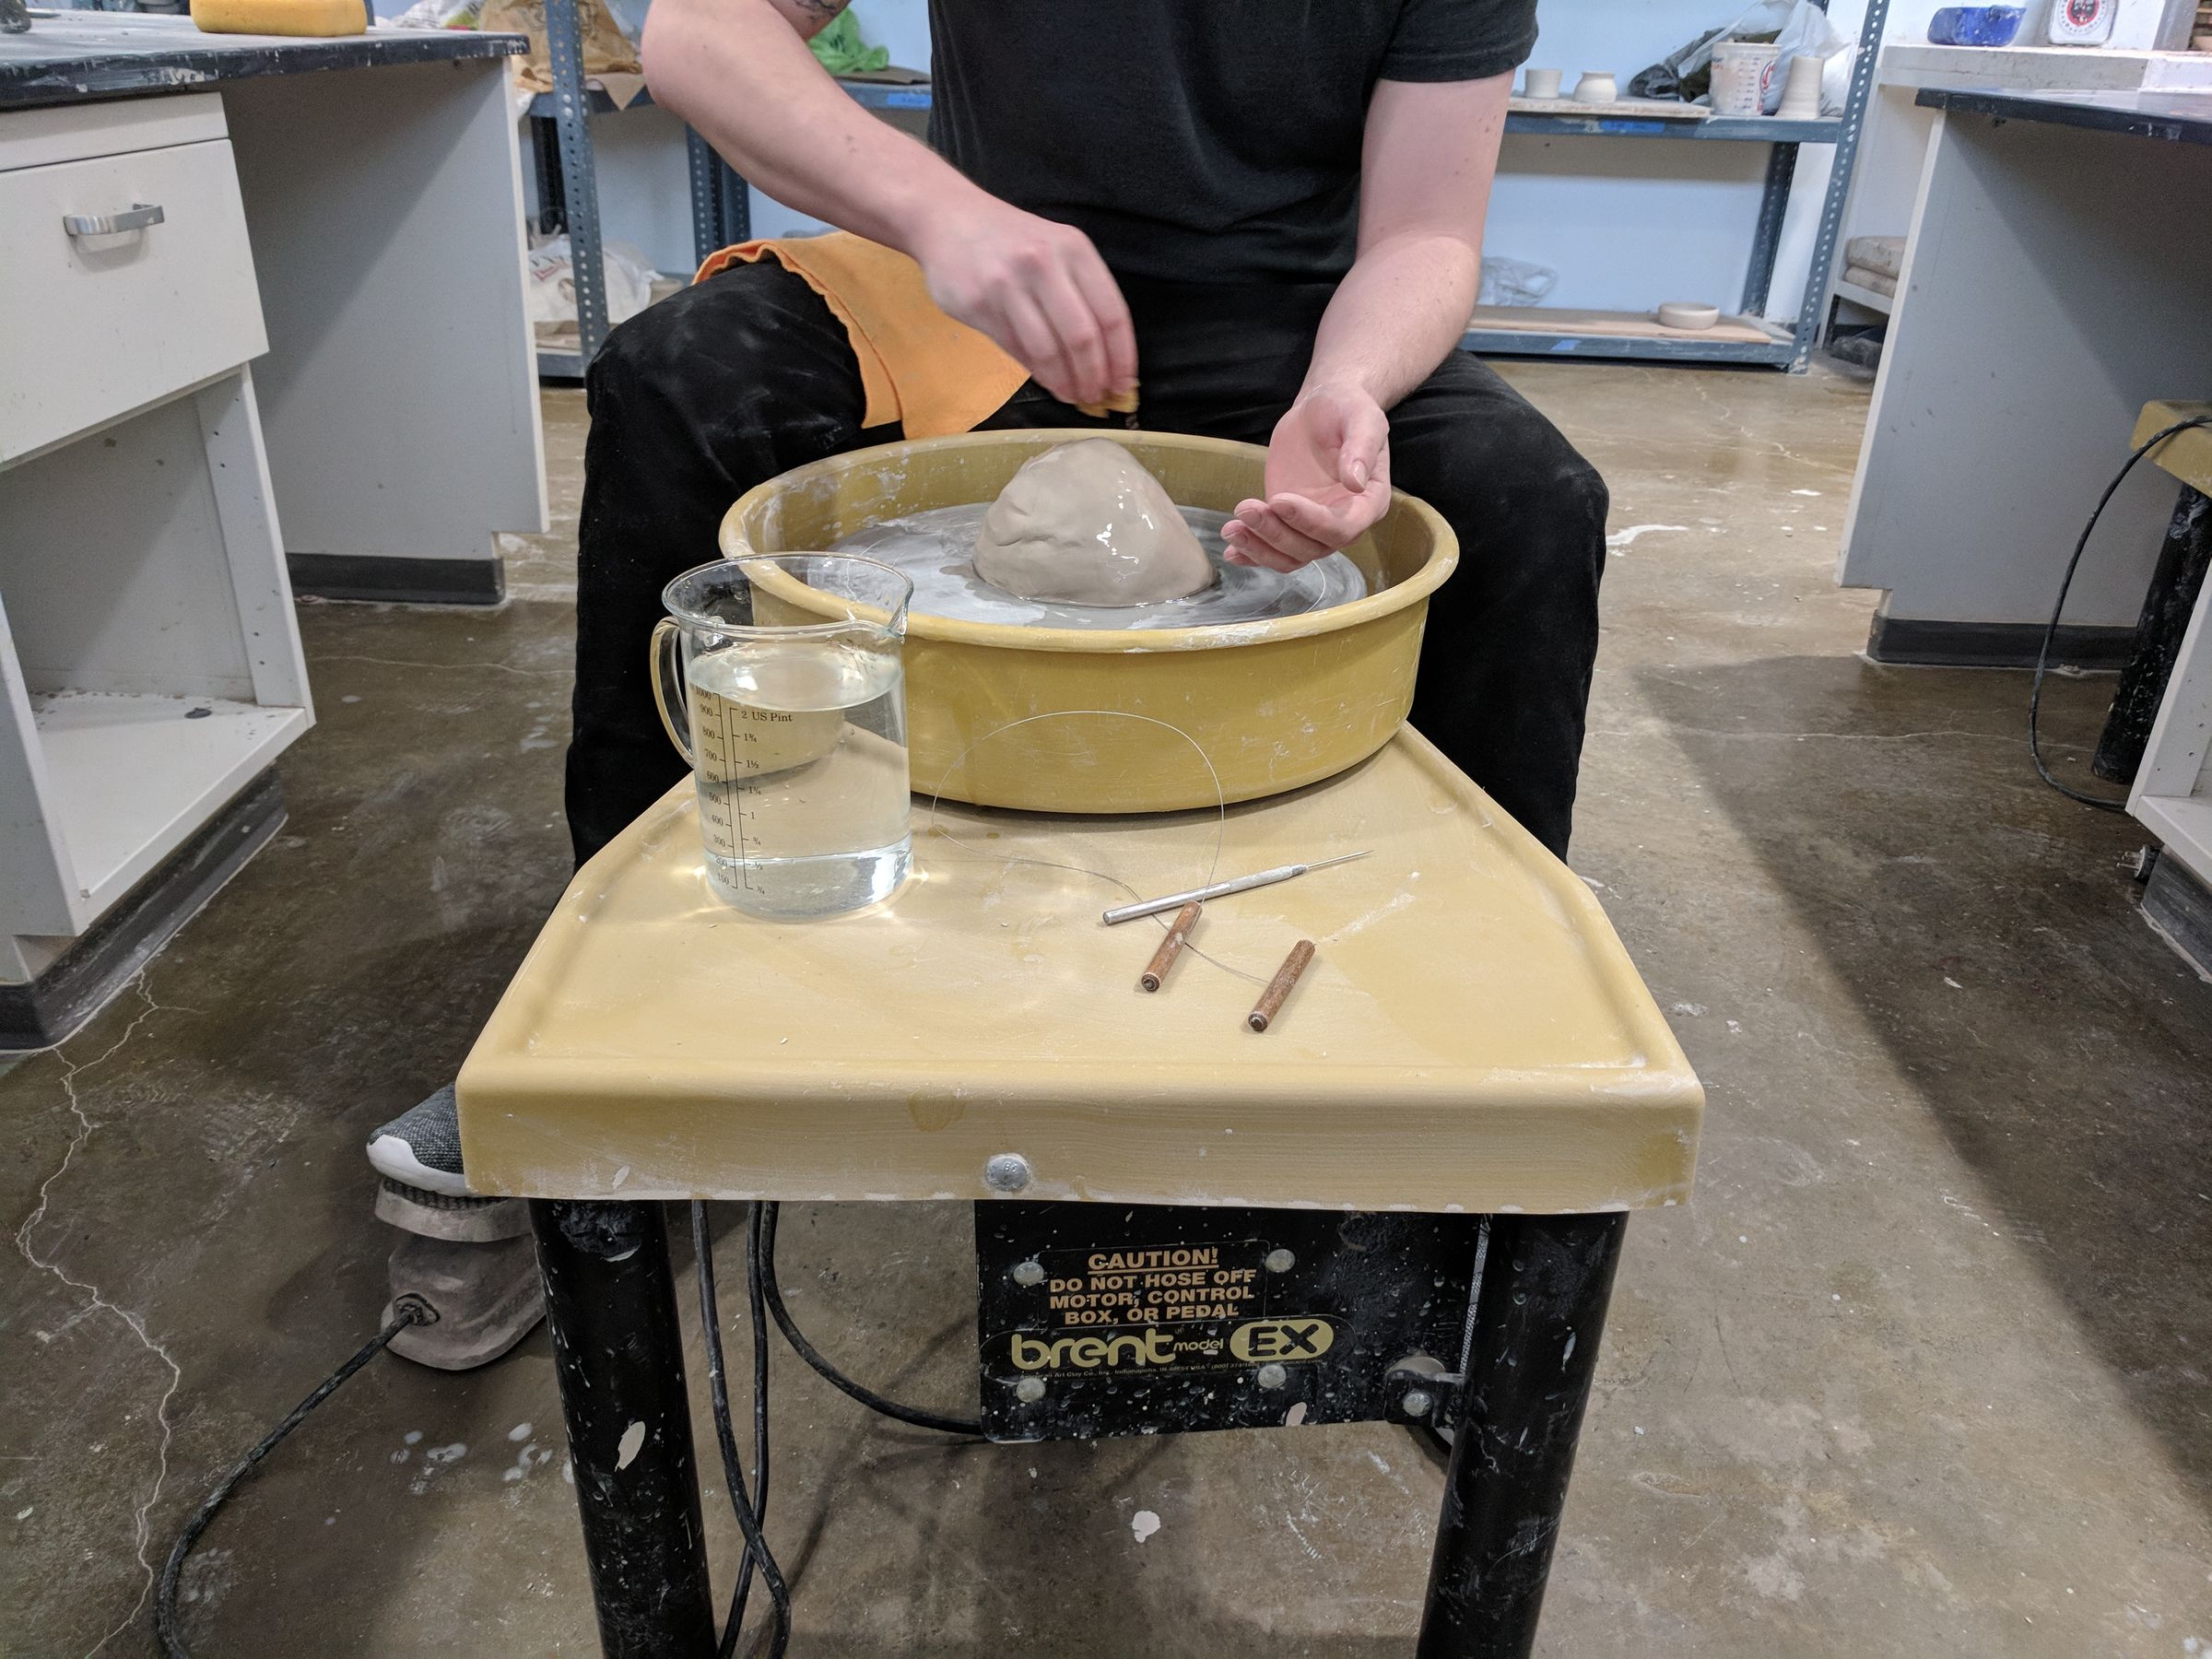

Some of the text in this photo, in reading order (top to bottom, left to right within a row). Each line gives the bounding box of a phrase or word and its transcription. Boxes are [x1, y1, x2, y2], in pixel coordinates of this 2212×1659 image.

[741, 711, 794, 722] 2 US Pint
[704, 748, 717, 761] 700
[706, 771, 720, 783] 600
[1088, 1246, 1218, 1270] CAUTION!
[1050, 1269, 1257, 1293] DO NOT HOSE OFF
[1049, 1286, 1255, 1310] MOTOR, CONTROL
[1065, 1303, 1240, 1325] BOX, OR PEDAL
[1011, 1324, 1319, 1371] brent model EX
